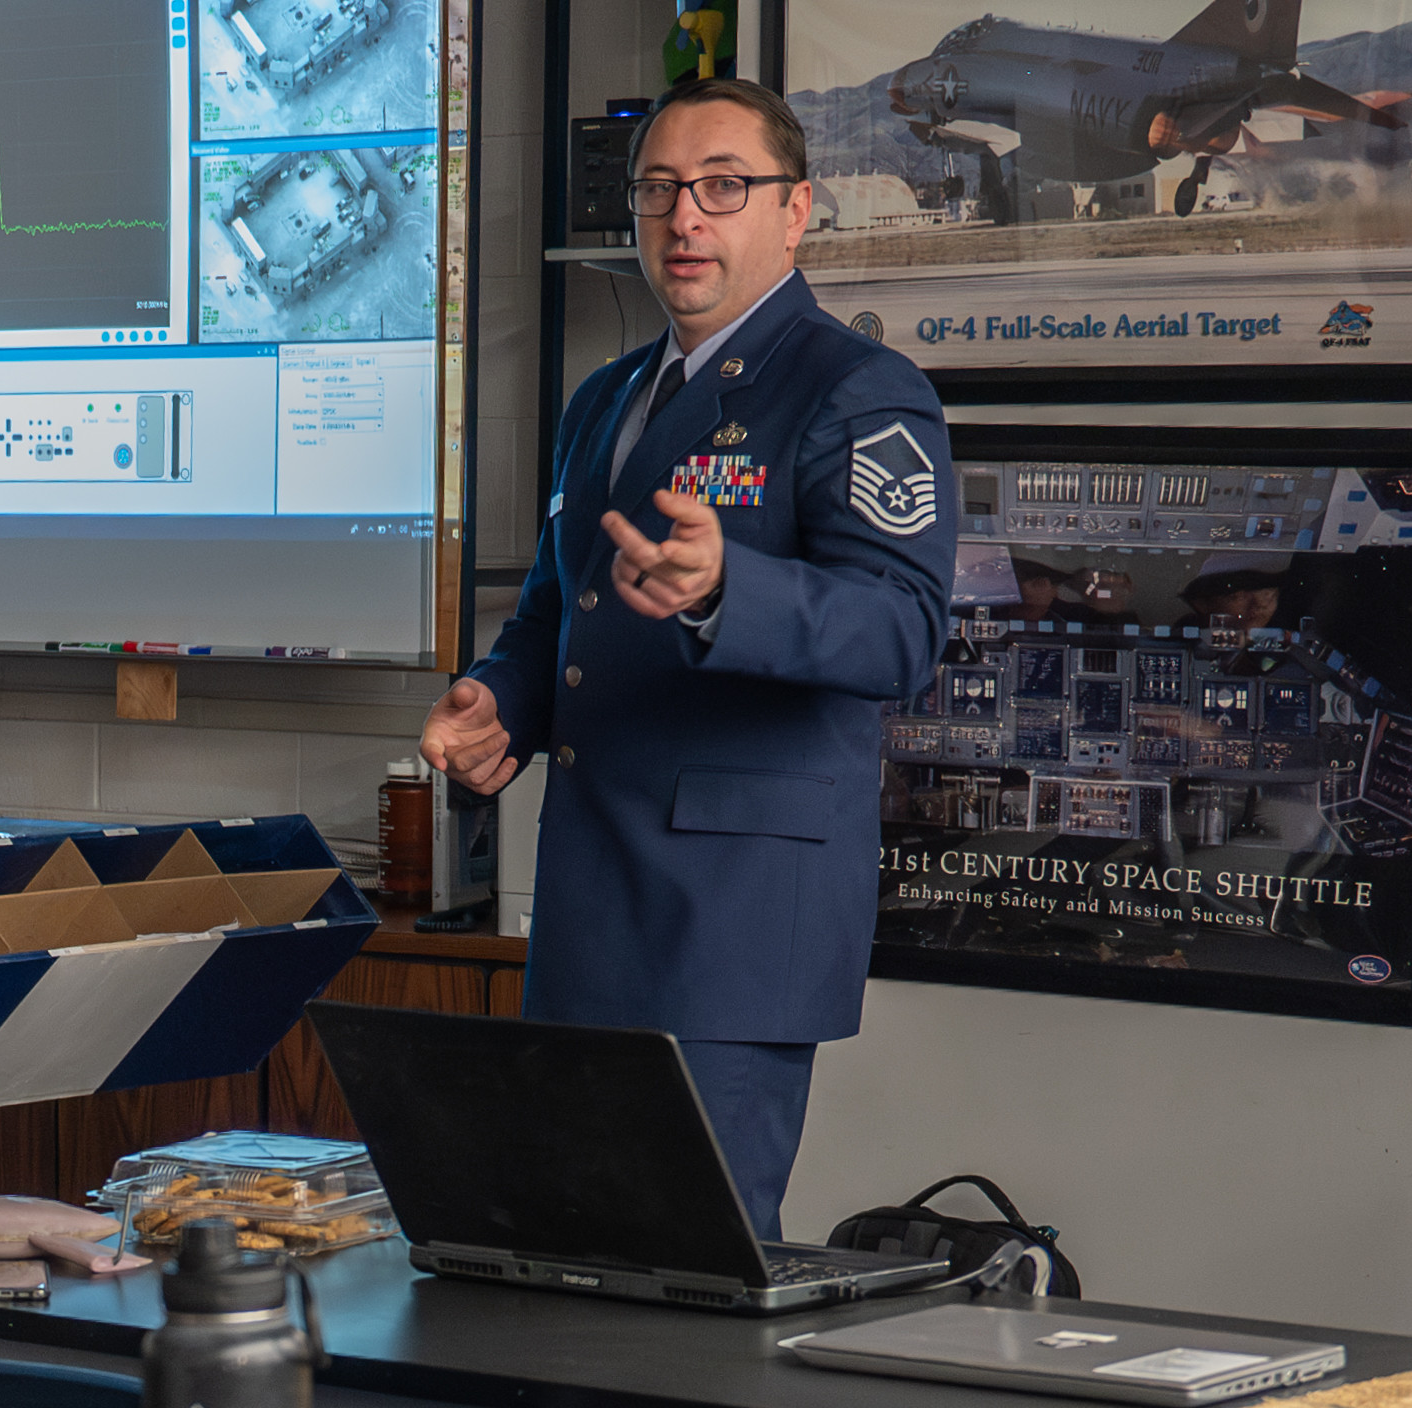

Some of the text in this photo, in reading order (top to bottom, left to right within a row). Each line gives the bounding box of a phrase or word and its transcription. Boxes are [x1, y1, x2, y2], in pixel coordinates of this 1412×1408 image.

[1070, 88, 1131, 129] NAVY
[917, 311, 1283, 345] QF-4 Full-Scale Aerial Target
[940, 849, 1091, 886] CENTURY
[1102, 862, 1203, 896] SPACE
[1215, 870, 1374, 908] SHUTTLE
[898, 882, 1266, 927] Enhancing Safety and Mission Success
